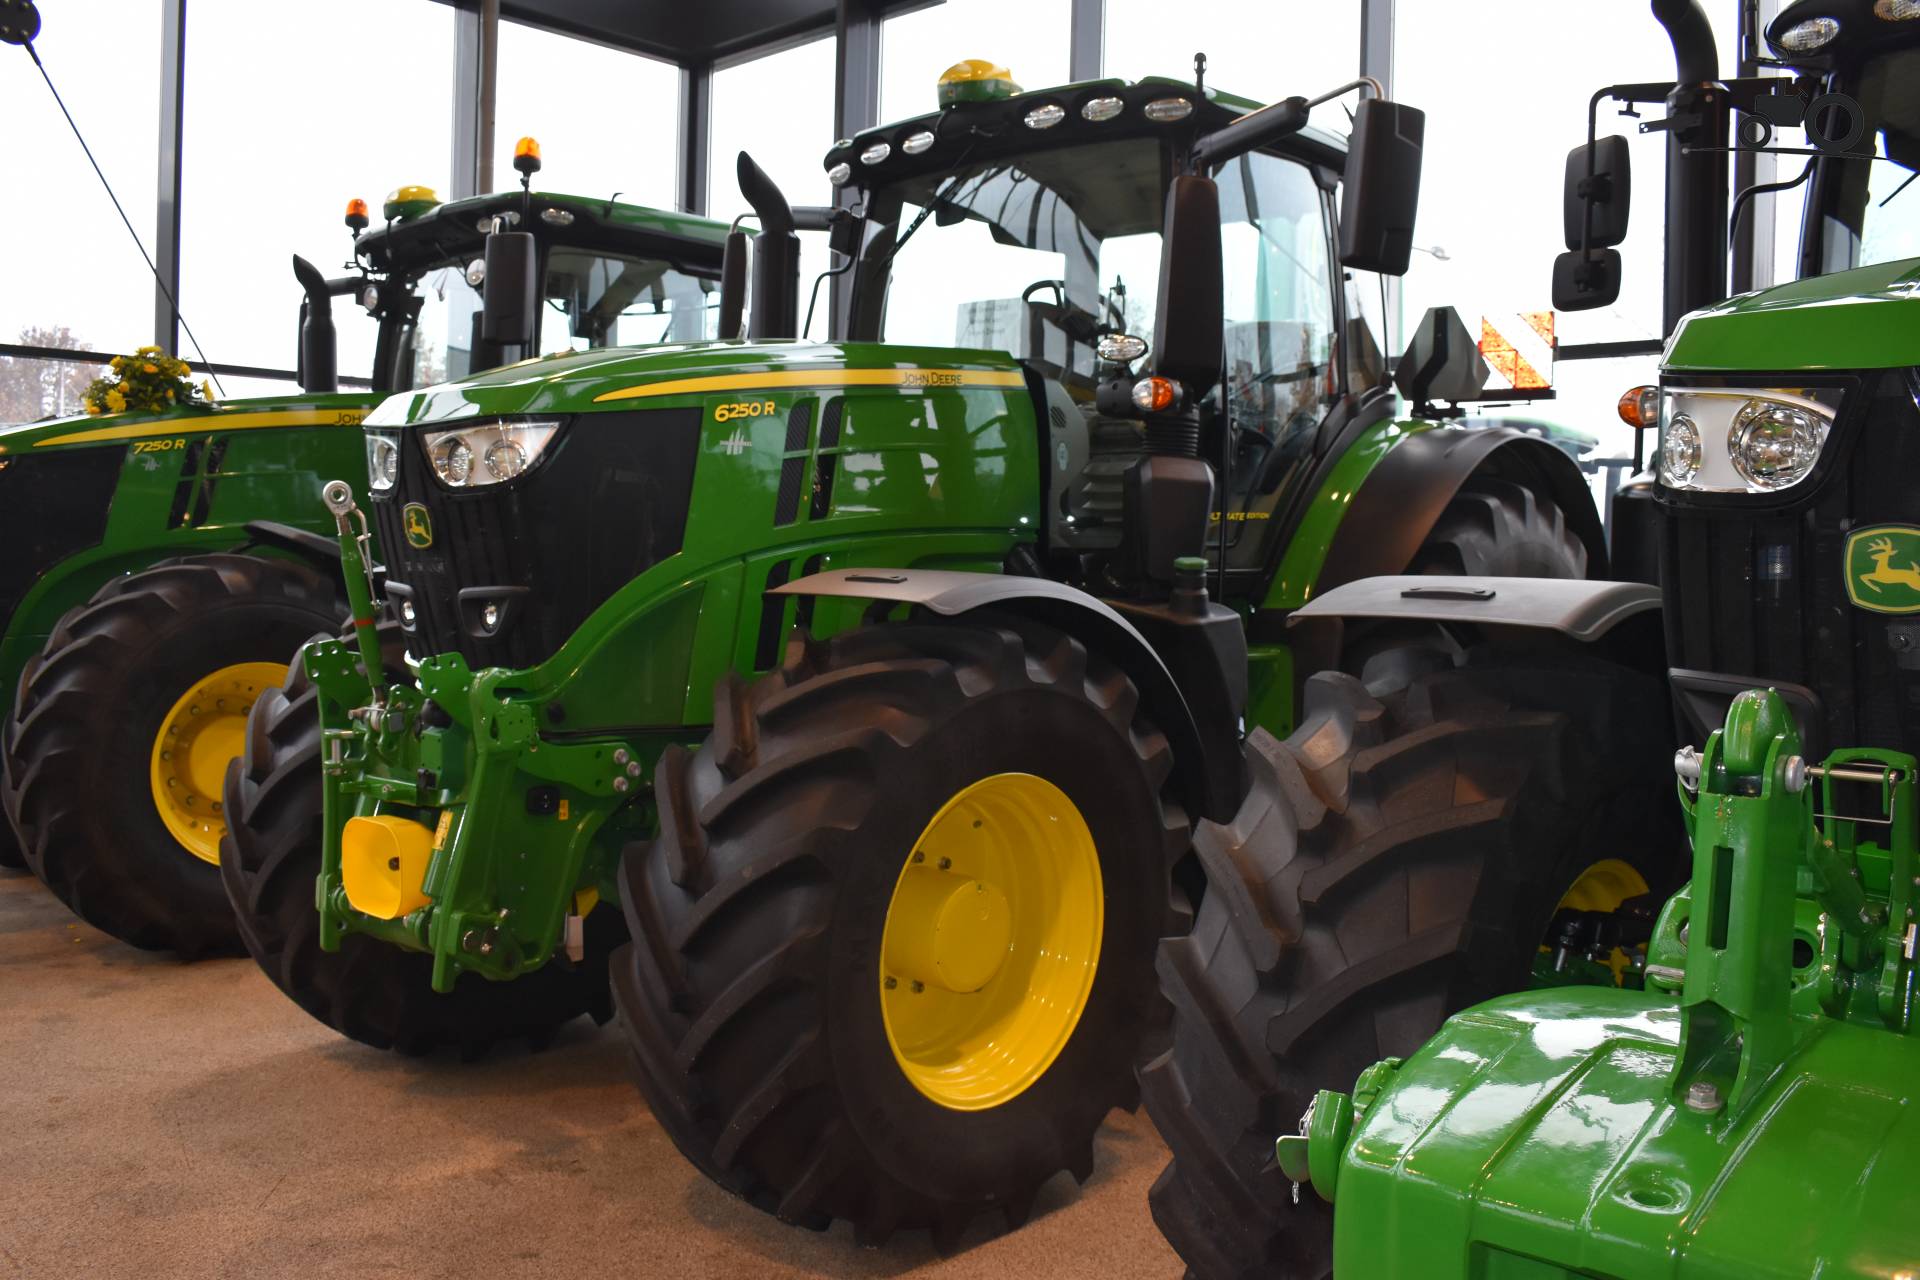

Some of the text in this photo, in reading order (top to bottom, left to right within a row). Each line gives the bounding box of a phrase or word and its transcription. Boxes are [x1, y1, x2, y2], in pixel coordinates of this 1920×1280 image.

[902, 371, 963, 385] JOHN DEERE
[714, 402, 762, 423] 6250
[133, 440, 172, 456] 7250
